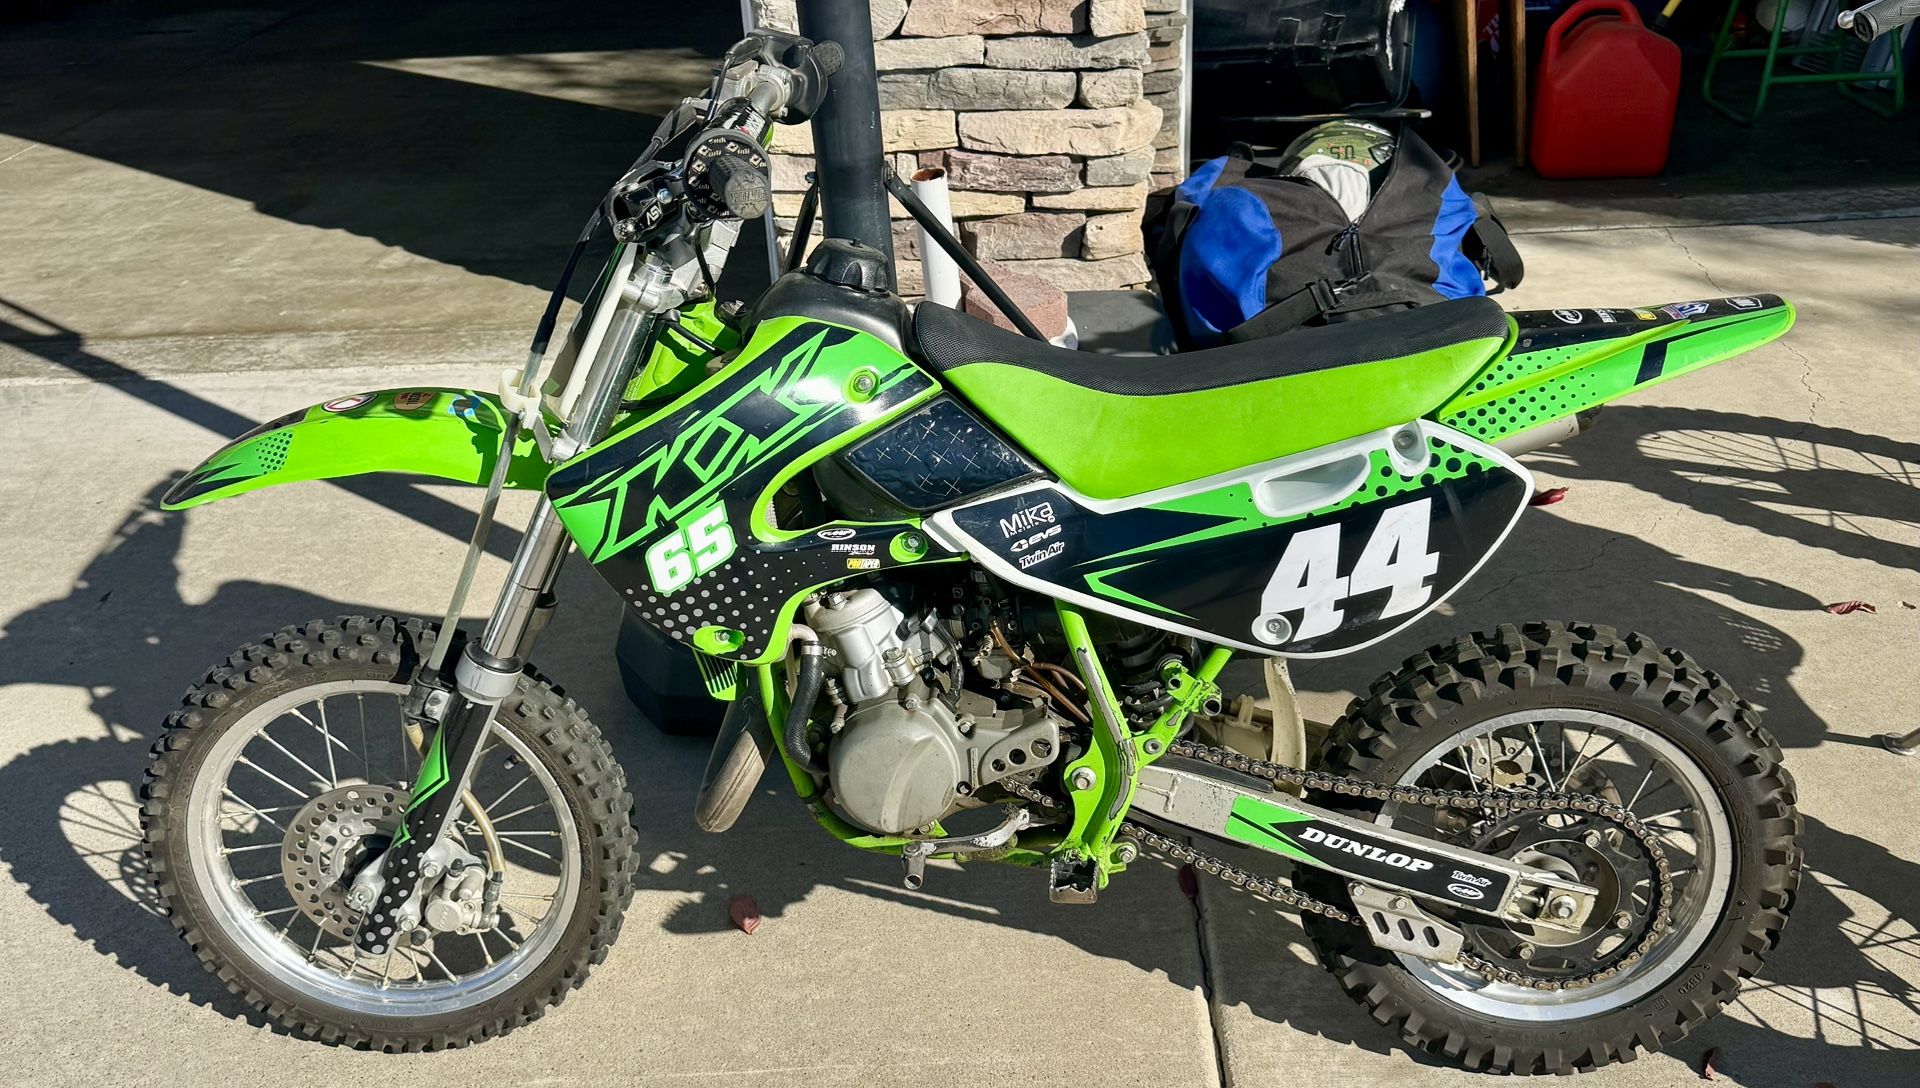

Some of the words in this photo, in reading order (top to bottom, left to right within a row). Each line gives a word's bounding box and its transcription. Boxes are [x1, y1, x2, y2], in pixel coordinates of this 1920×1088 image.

[645, 499, 738, 593] 65
[1019, 549, 1048, 569] Twin
[1048, 541, 1065, 557] Air
[1260, 497, 1440, 642] 44
[1298, 827, 1434, 872] DUNLOP
[1451, 870, 1477, 883] Twin
